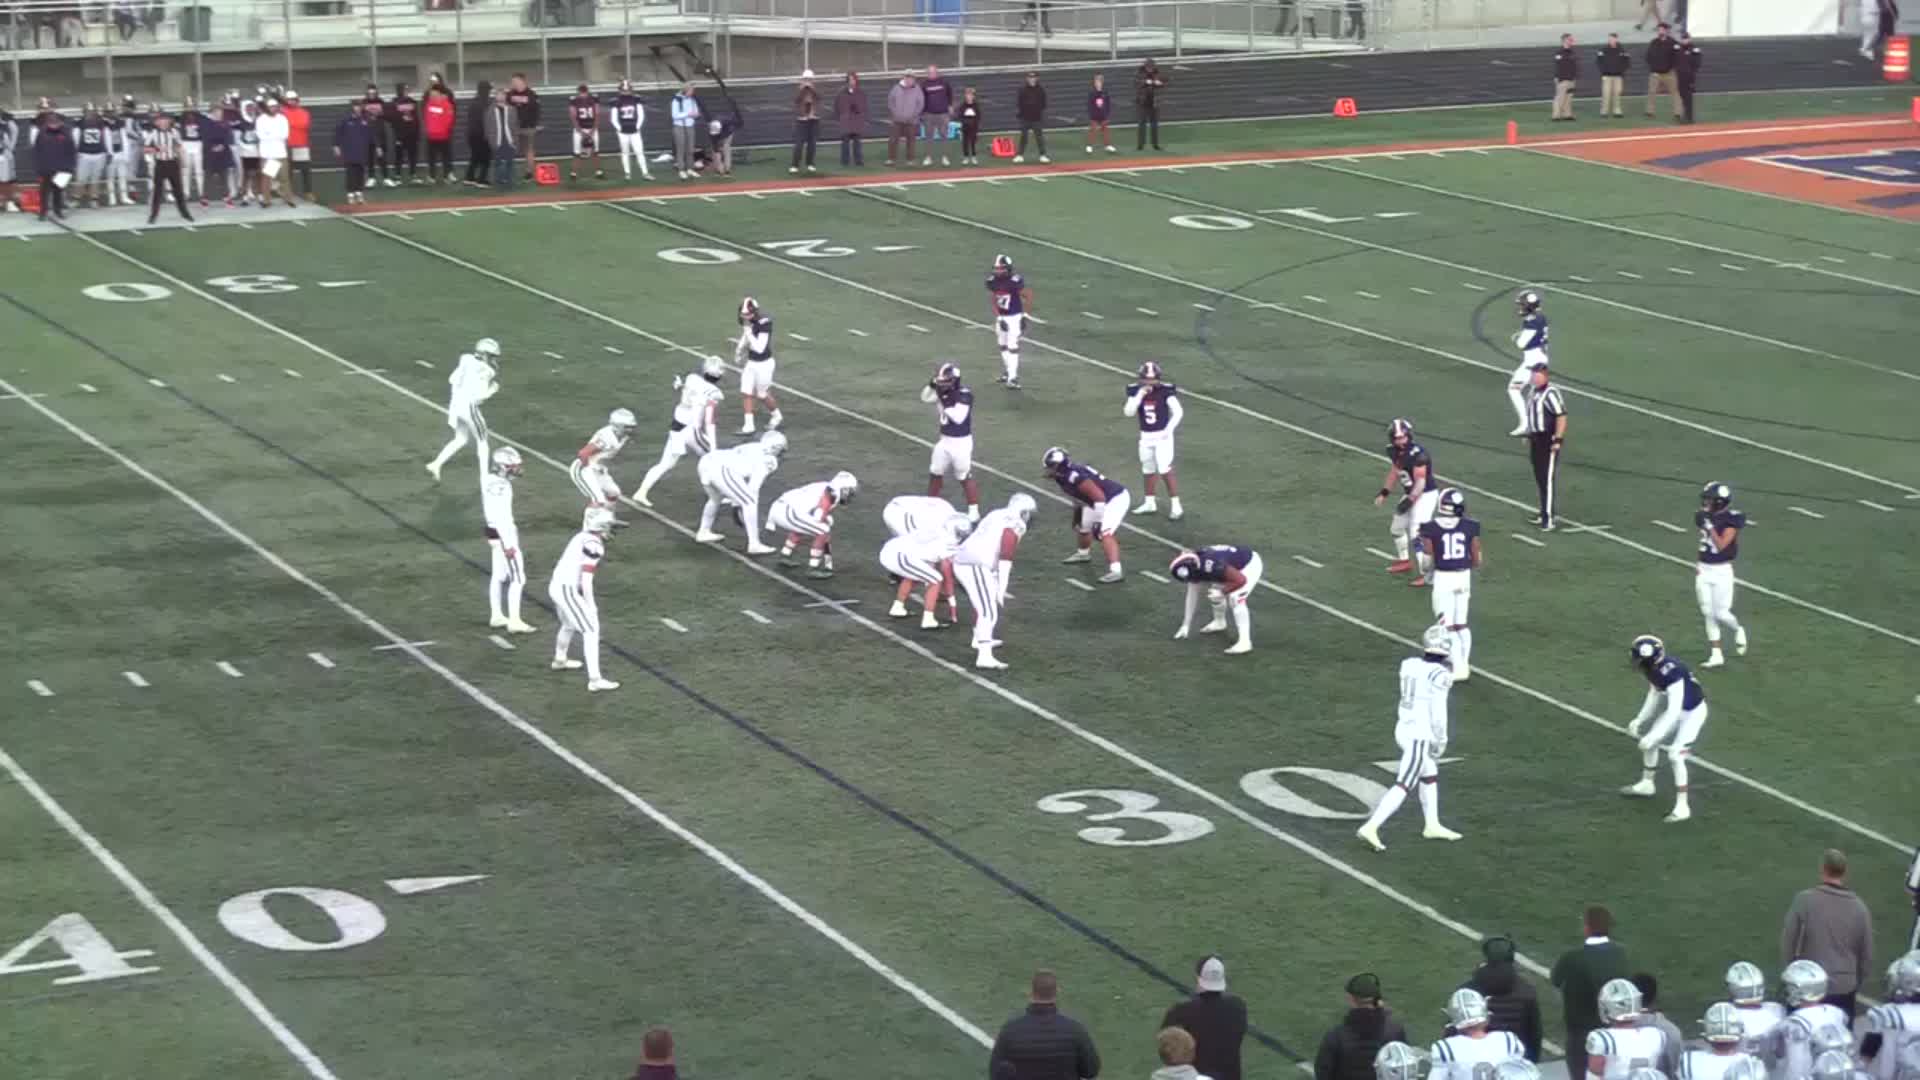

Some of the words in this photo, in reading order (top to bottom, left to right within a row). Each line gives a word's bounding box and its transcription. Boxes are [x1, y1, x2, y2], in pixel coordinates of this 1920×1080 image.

[1144, 404, 1158, 425] 5
[1442, 532, 1466, 560] 16
[1036, 766, 1390, 846] 30
[0, 886, 387, 985] 40
